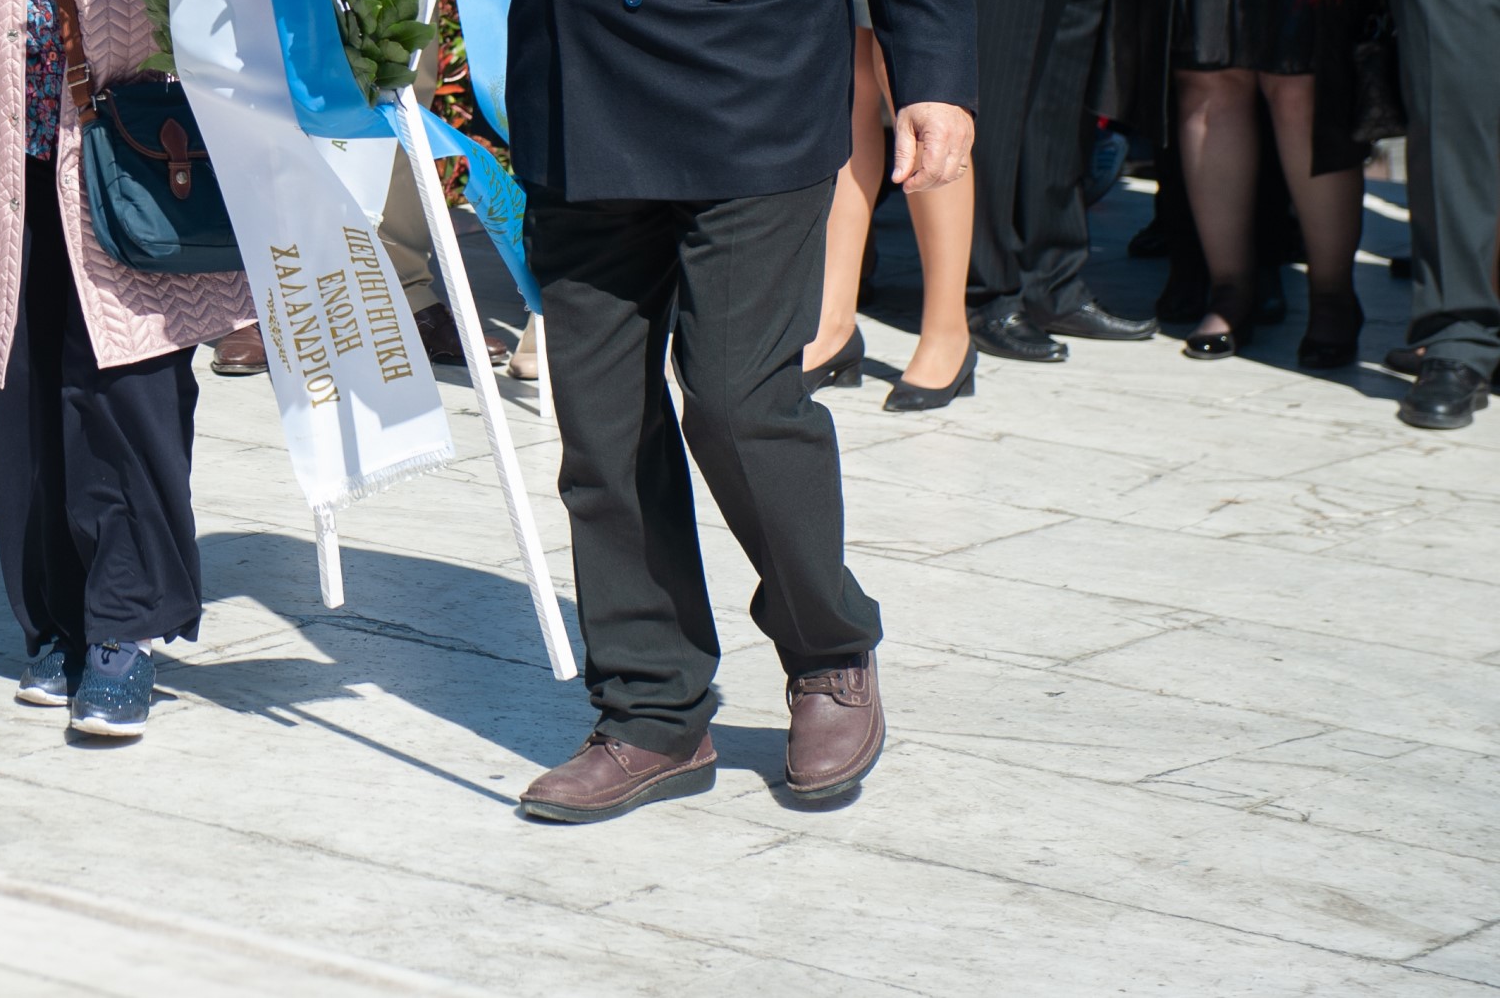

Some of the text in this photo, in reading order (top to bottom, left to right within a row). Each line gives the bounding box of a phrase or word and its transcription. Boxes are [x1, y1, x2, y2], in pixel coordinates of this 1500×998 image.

[270, 243, 341, 409] ΧΑΛΑΝΔΡΙΟΥ
[316, 269, 364, 358] ΕΝΩΣΗ
[342, 225, 414, 384] ΠΕΡΙΗΓΗΤΙΚΗ
